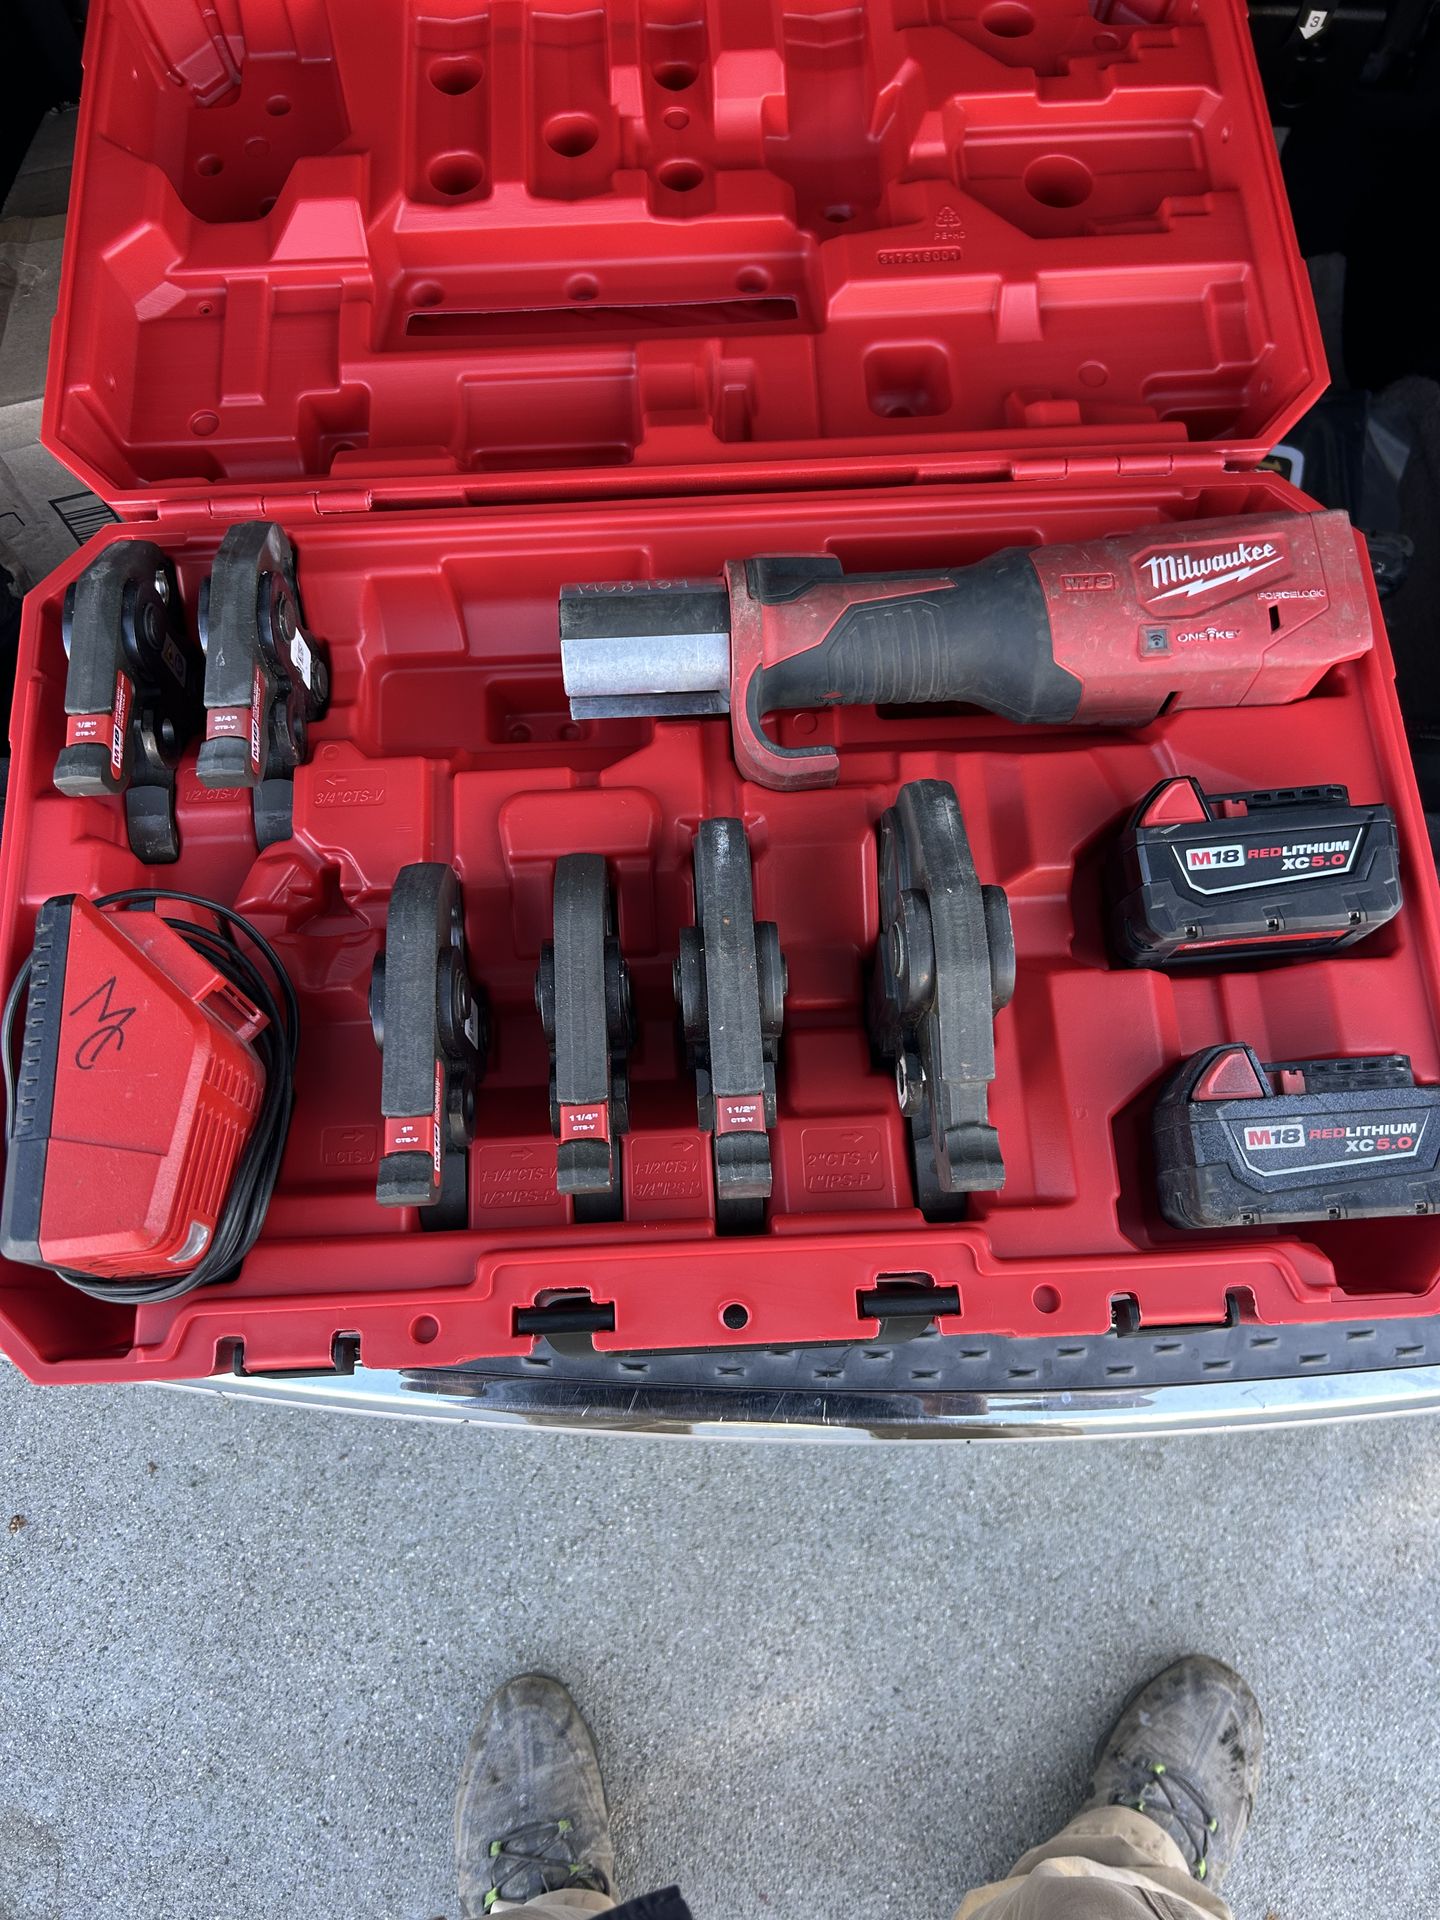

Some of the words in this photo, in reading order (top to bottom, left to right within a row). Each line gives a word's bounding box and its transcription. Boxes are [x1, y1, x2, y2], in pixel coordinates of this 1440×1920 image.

[1310, 16, 1321, 28] 3
[1140, 543, 1277, 589] Milwaukee
[1063, 576, 1114, 591] M18
[314, 789, 385, 805] 3/4"CTS-V
[1189, 849, 1241, 868] M18
[1247, 1128, 1302, 1146] M18
